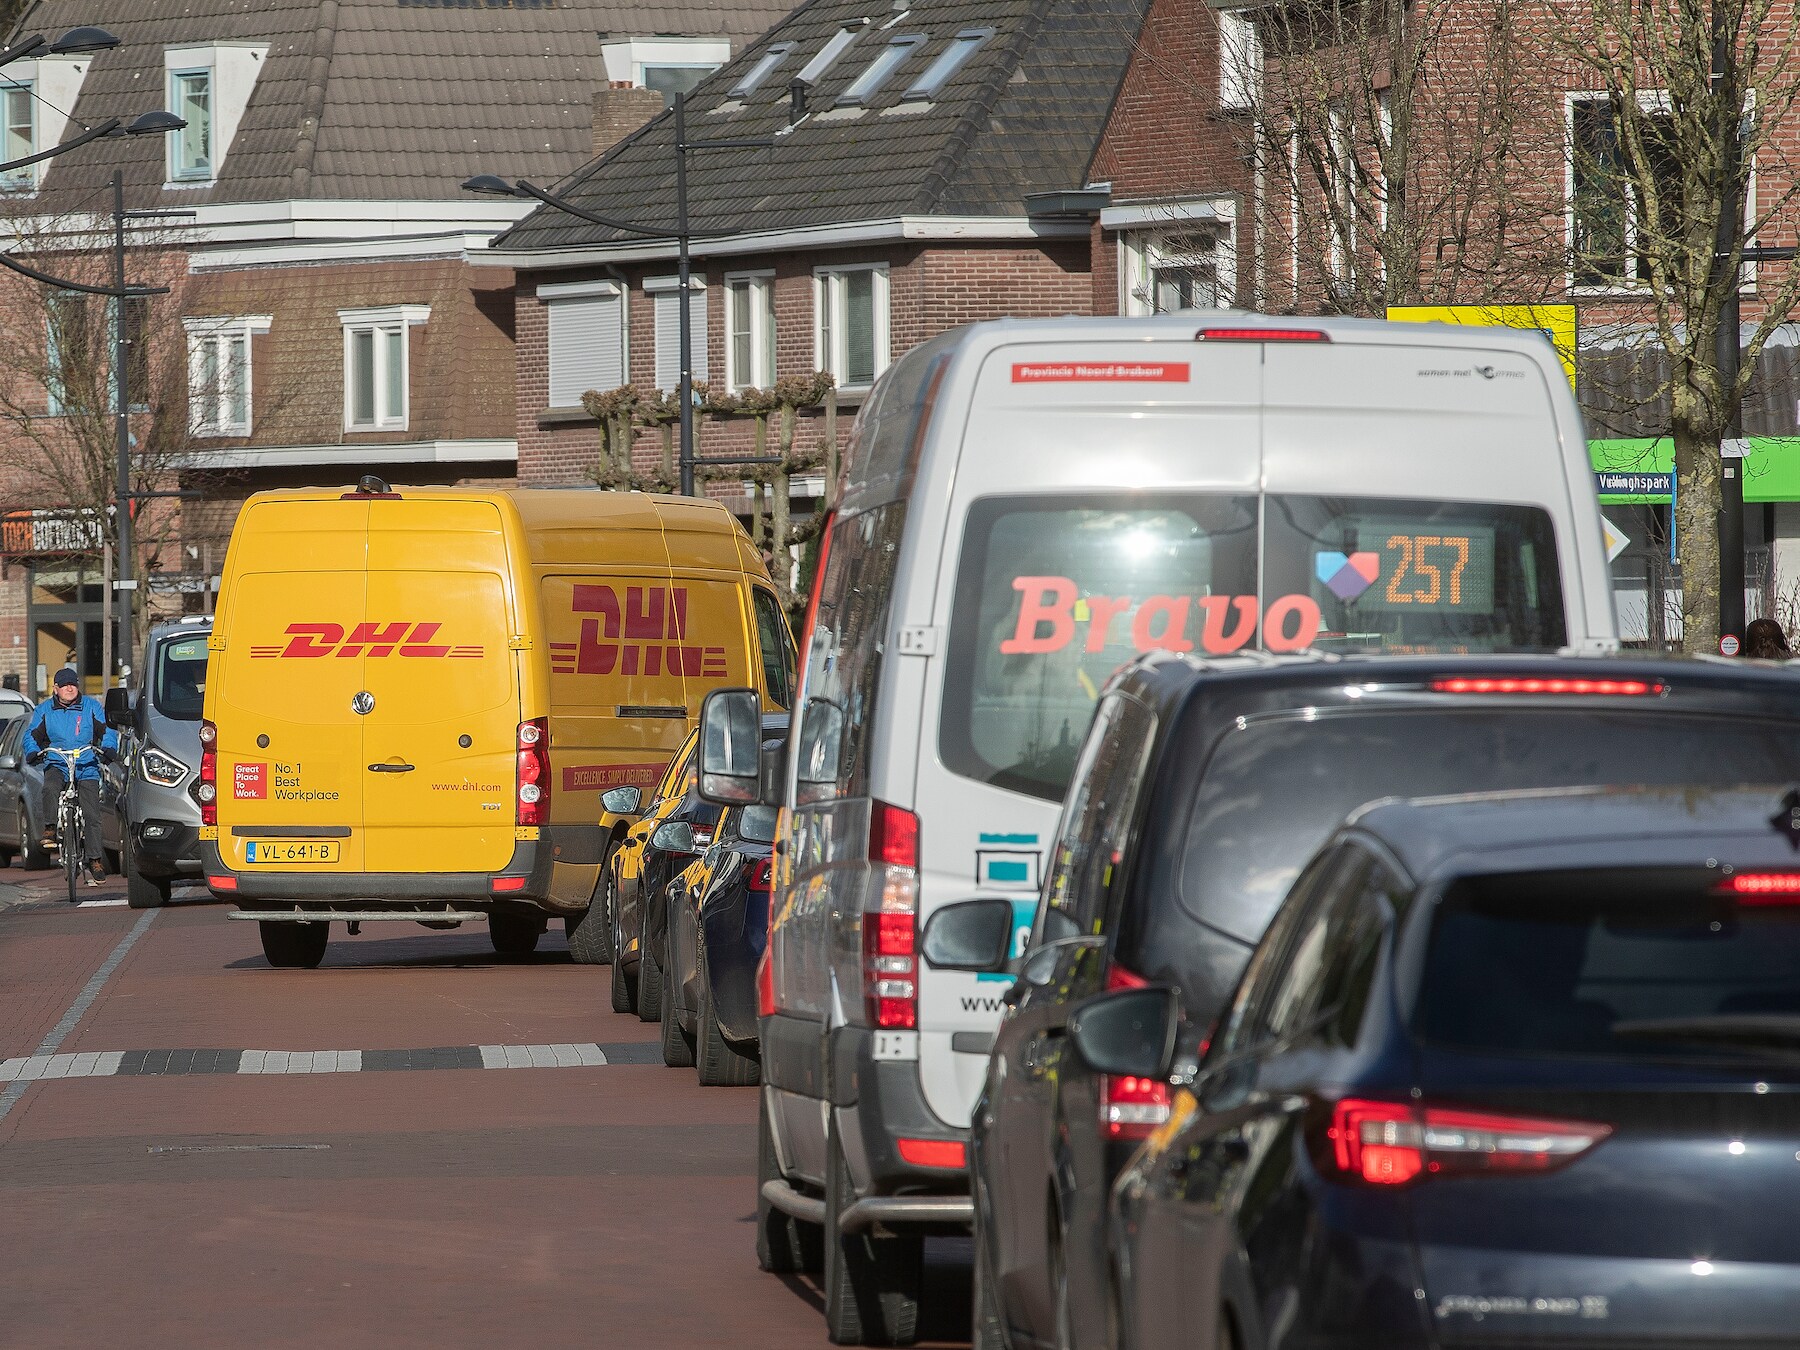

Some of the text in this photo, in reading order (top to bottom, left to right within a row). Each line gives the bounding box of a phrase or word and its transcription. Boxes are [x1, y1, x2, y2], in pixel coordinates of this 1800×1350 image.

[1021, 366, 1073, 377] Provincie
[1386, 535, 1469, 605] 257
[1001, 576, 1322, 654] Bravo
[572, 584, 703, 677] DHL
[281, 622, 452, 658] DHL
[235, 765, 260, 773] Great
[275, 763, 302, 774] No. 1
[235, 773, 259, 781] Place
[275, 776, 300, 787] Best
[607, 769, 626, 784] SIMPLY
[235, 781, 246, 789] To
[431, 782, 501, 792] www.dhl.com
[275, 789, 339, 802] Workplace
[481, 802, 502, 811] TDI
[262, 845, 329, 859] VL-641-B
